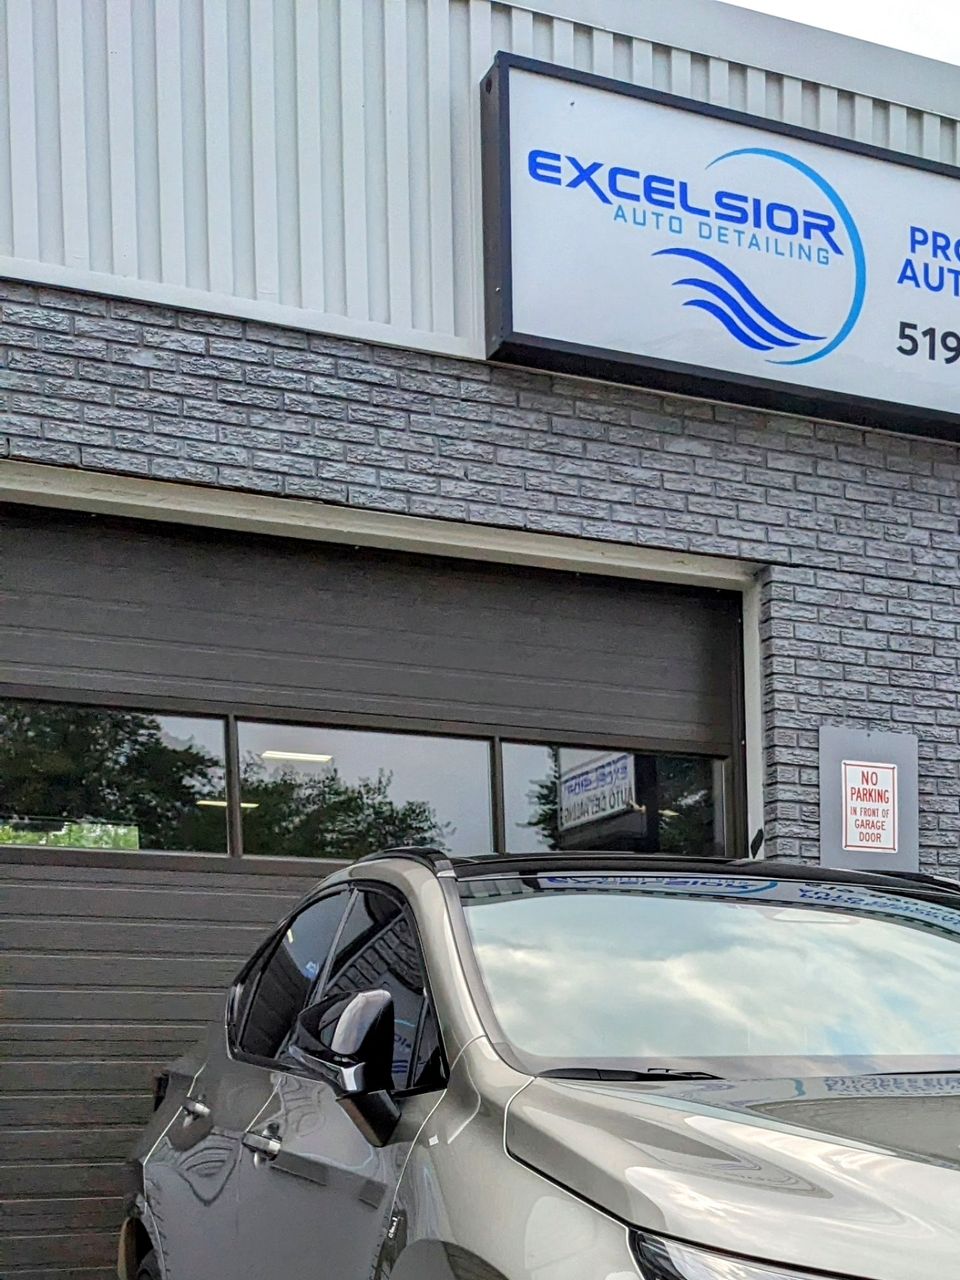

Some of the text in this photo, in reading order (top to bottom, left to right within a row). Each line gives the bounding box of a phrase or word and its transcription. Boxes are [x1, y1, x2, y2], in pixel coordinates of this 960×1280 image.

[528, 149, 844, 255] EXCELSIOR
[613, 204, 829, 265] AUTO DETAILING
[861, 770, 878, 786] NO
[850, 786, 890, 804] PARKING
[850, 806, 890, 818] IN FRONT OF
[854, 818, 886, 831] GARAGE
[858, 831, 882, 843] DOOR
